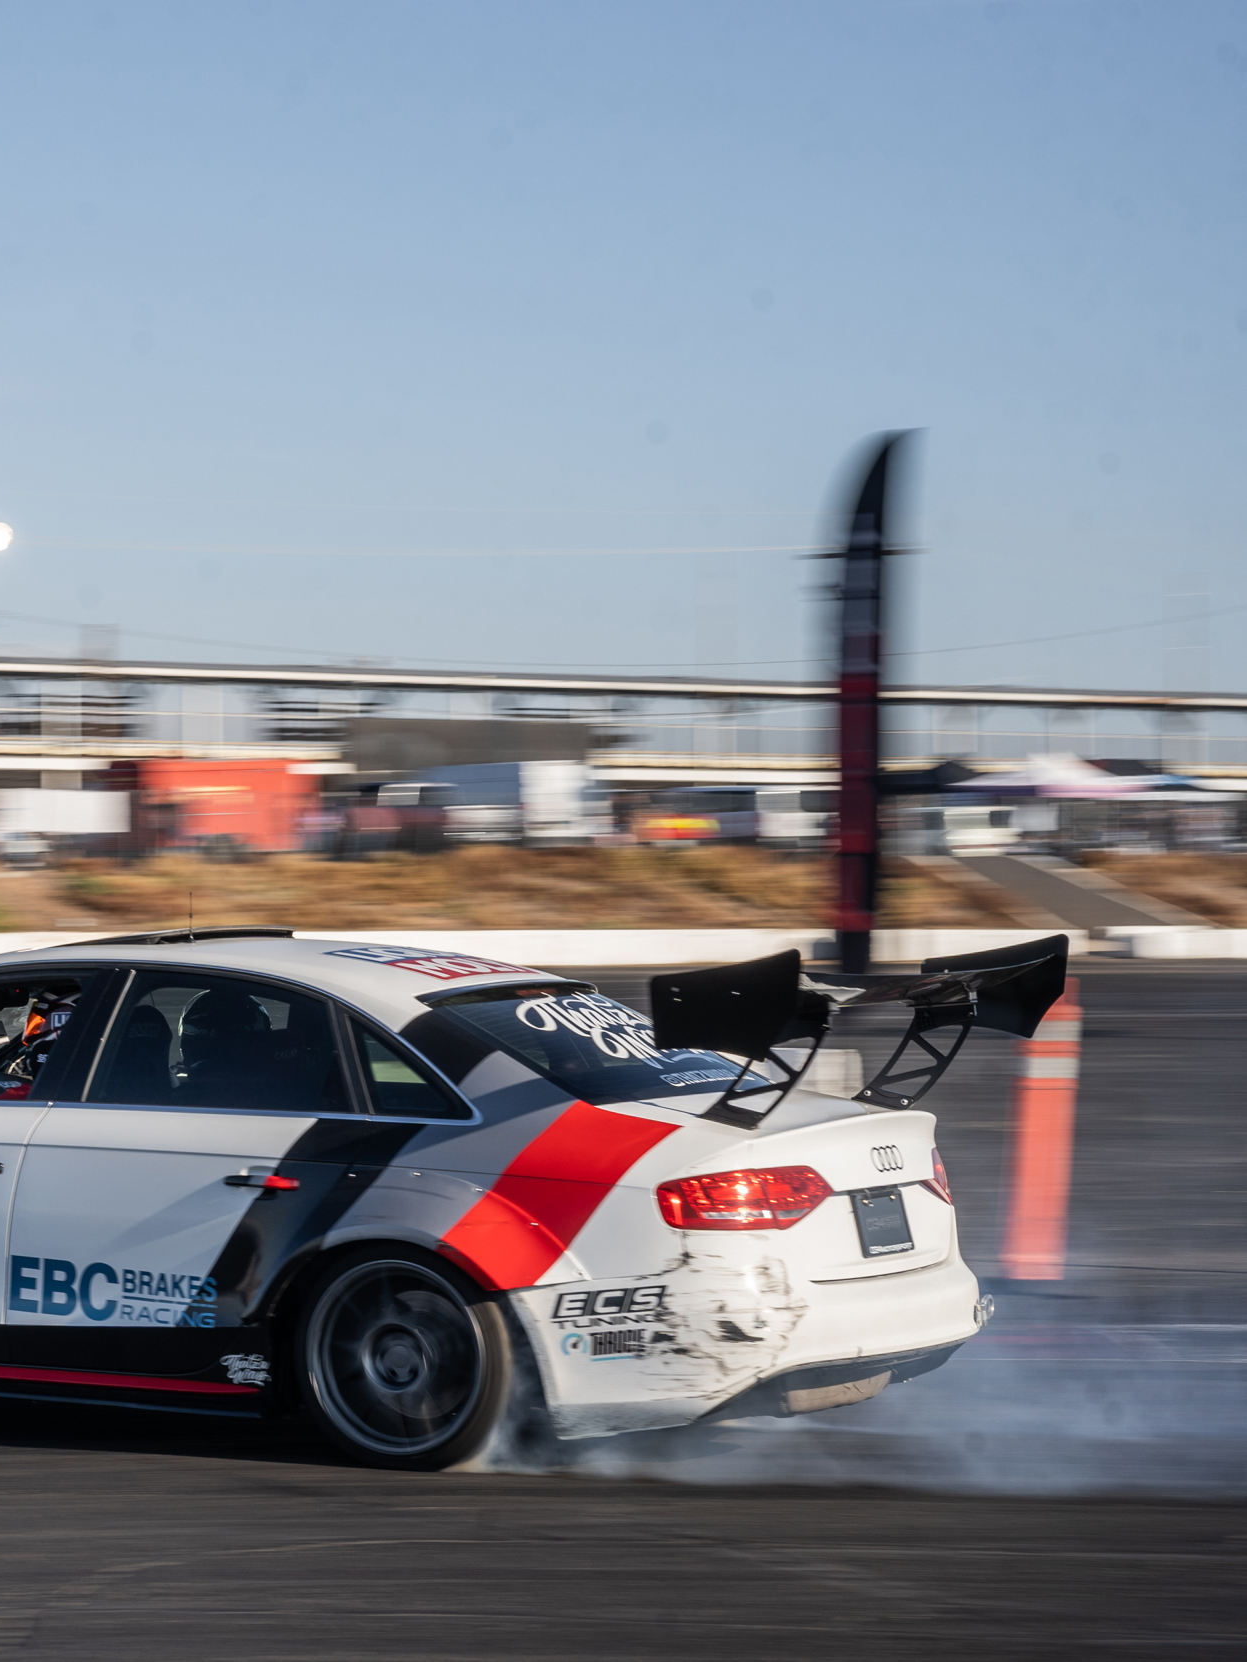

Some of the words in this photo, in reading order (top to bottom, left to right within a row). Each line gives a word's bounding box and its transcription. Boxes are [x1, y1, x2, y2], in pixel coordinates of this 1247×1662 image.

[9, 1255, 119, 1321] EBC
[122, 1269, 217, 1302] BRAKES
[119, 1304, 217, 1328] RACING
[555, 1286, 663, 1318] ECS
